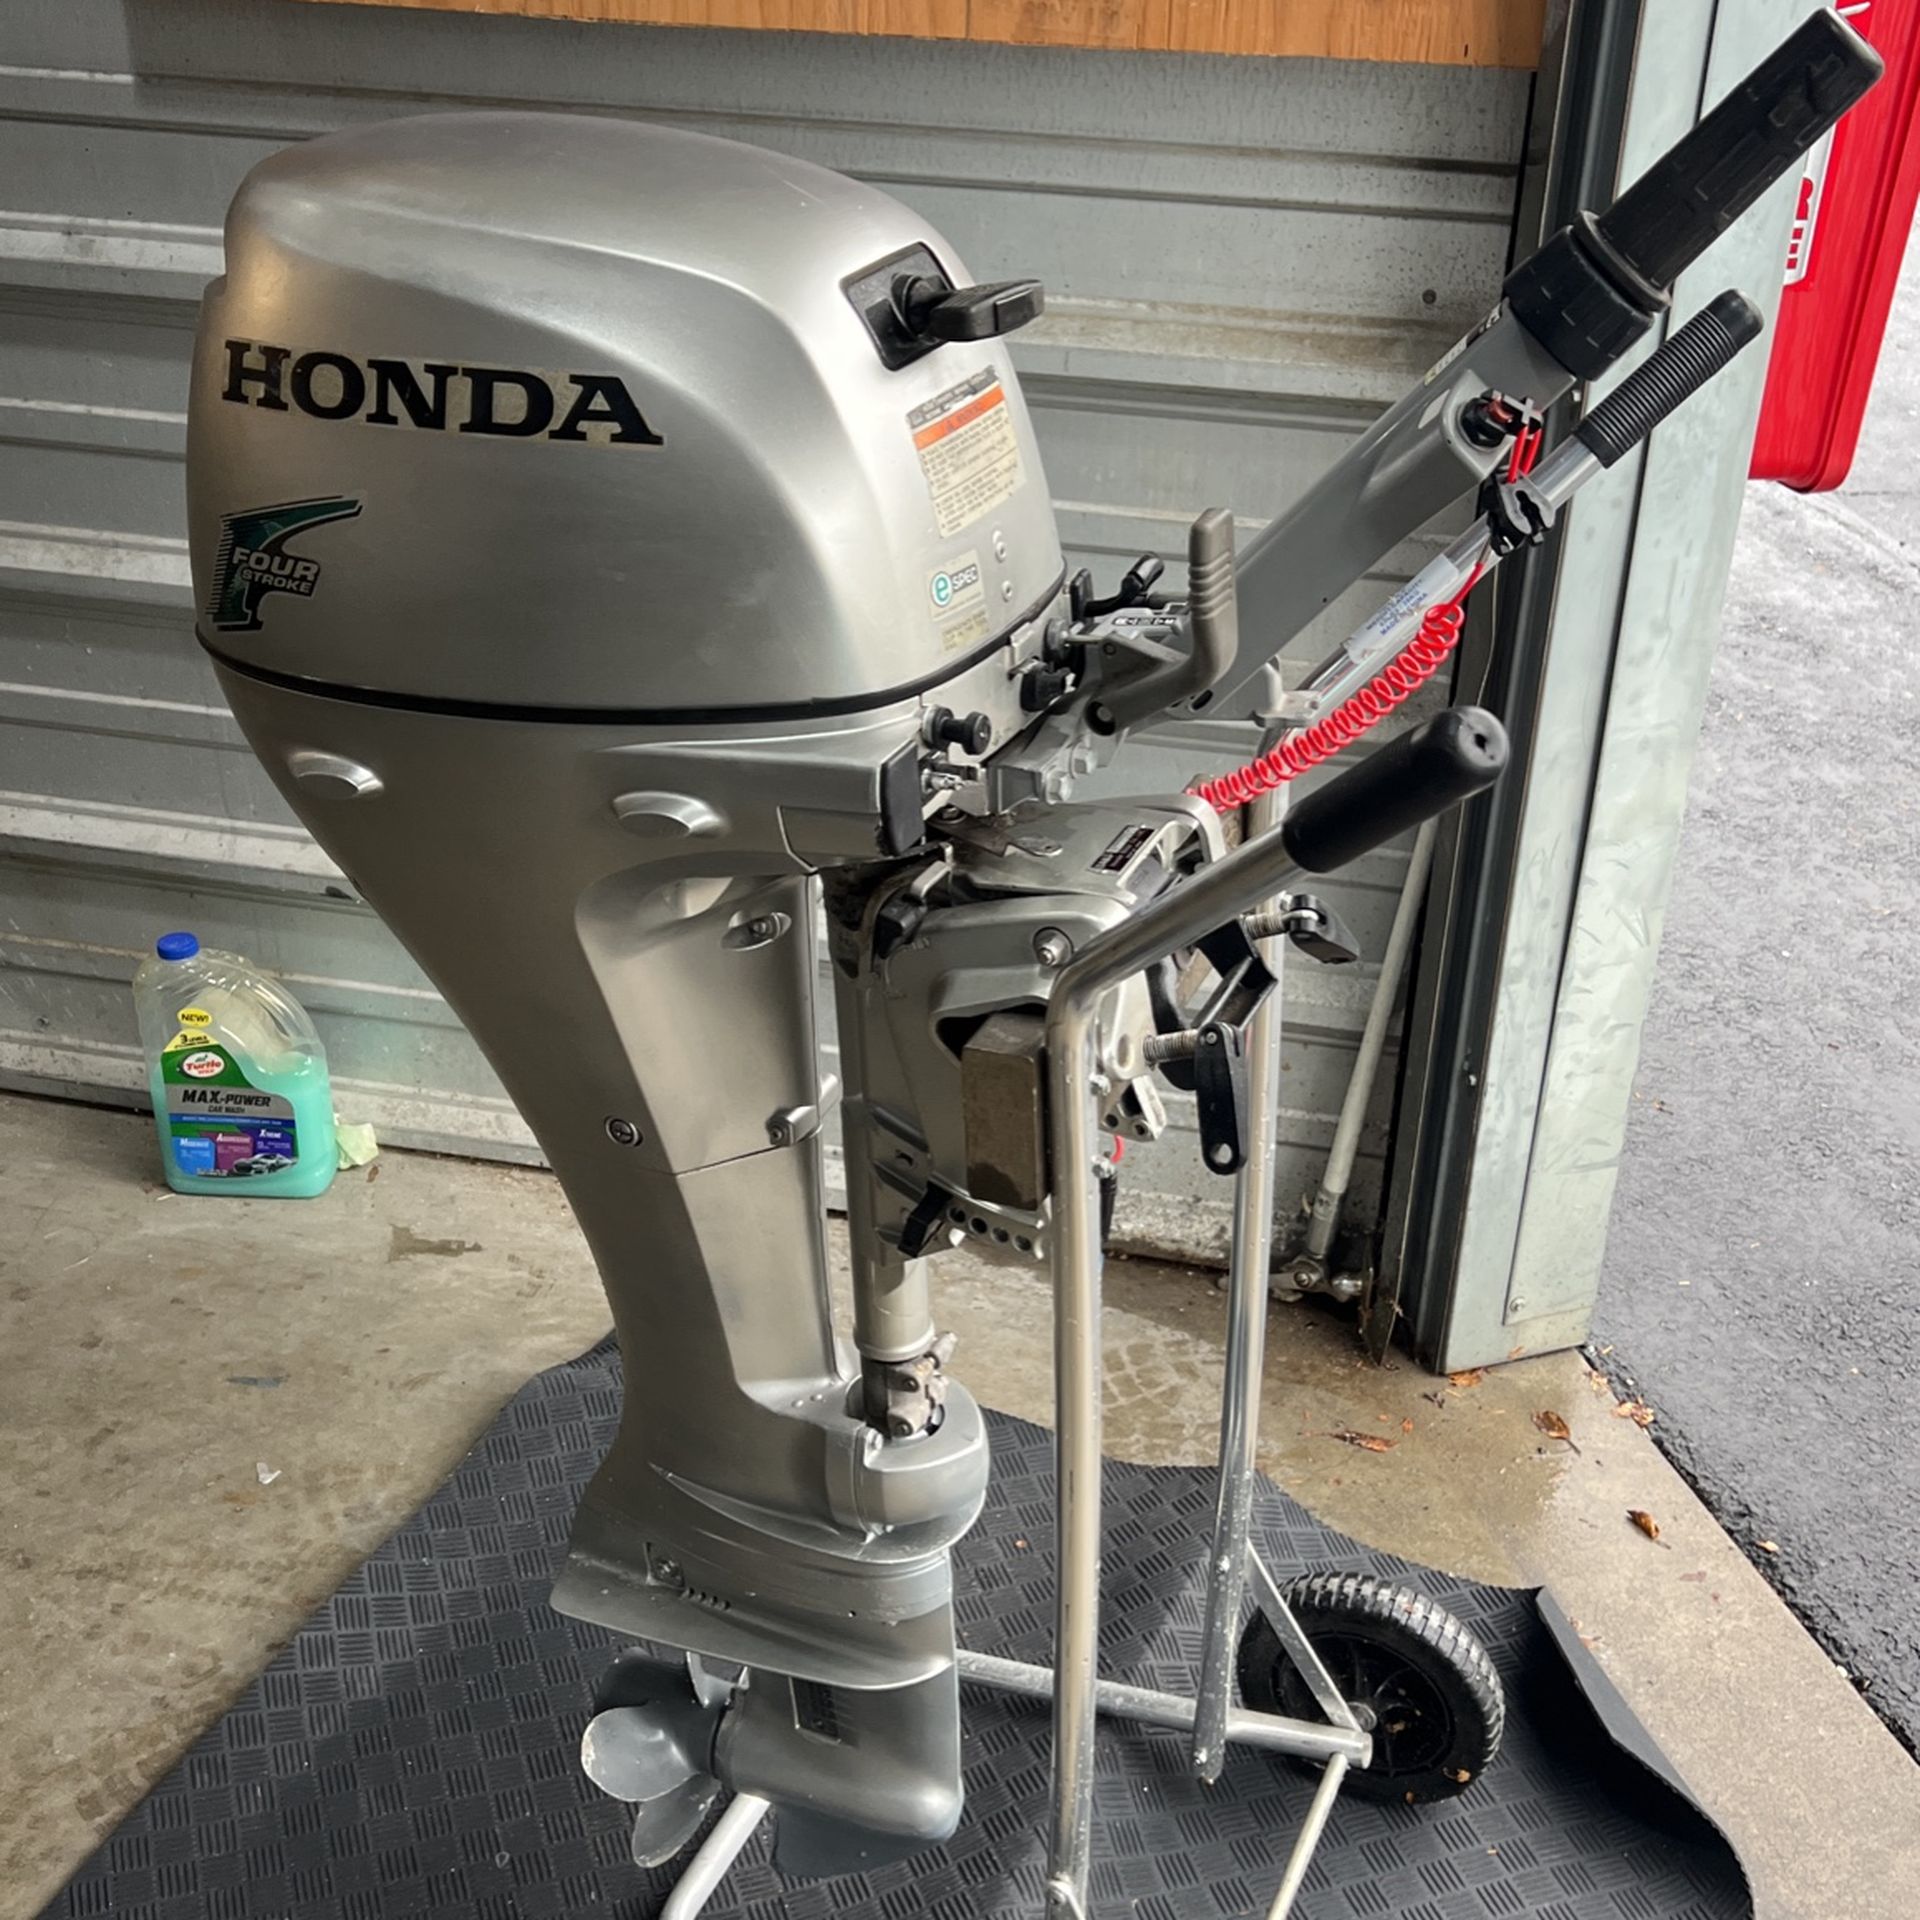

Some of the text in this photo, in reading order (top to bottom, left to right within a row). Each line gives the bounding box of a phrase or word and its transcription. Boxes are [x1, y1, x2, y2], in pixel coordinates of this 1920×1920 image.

[222, 339, 664, 446] HONDA
[231, 547, 319, 581] FOUR
[242, 568, 313, 594] STROKE
[181, 1013, 210, 1023] NEW!
[180, 1033, 188, 1045] 3
[186, 1060, 222, 1071] Turtle
[182, 1089, 272, 1107] MAX-POWER
[208, 1105, 246, 1114] CAR WASH
